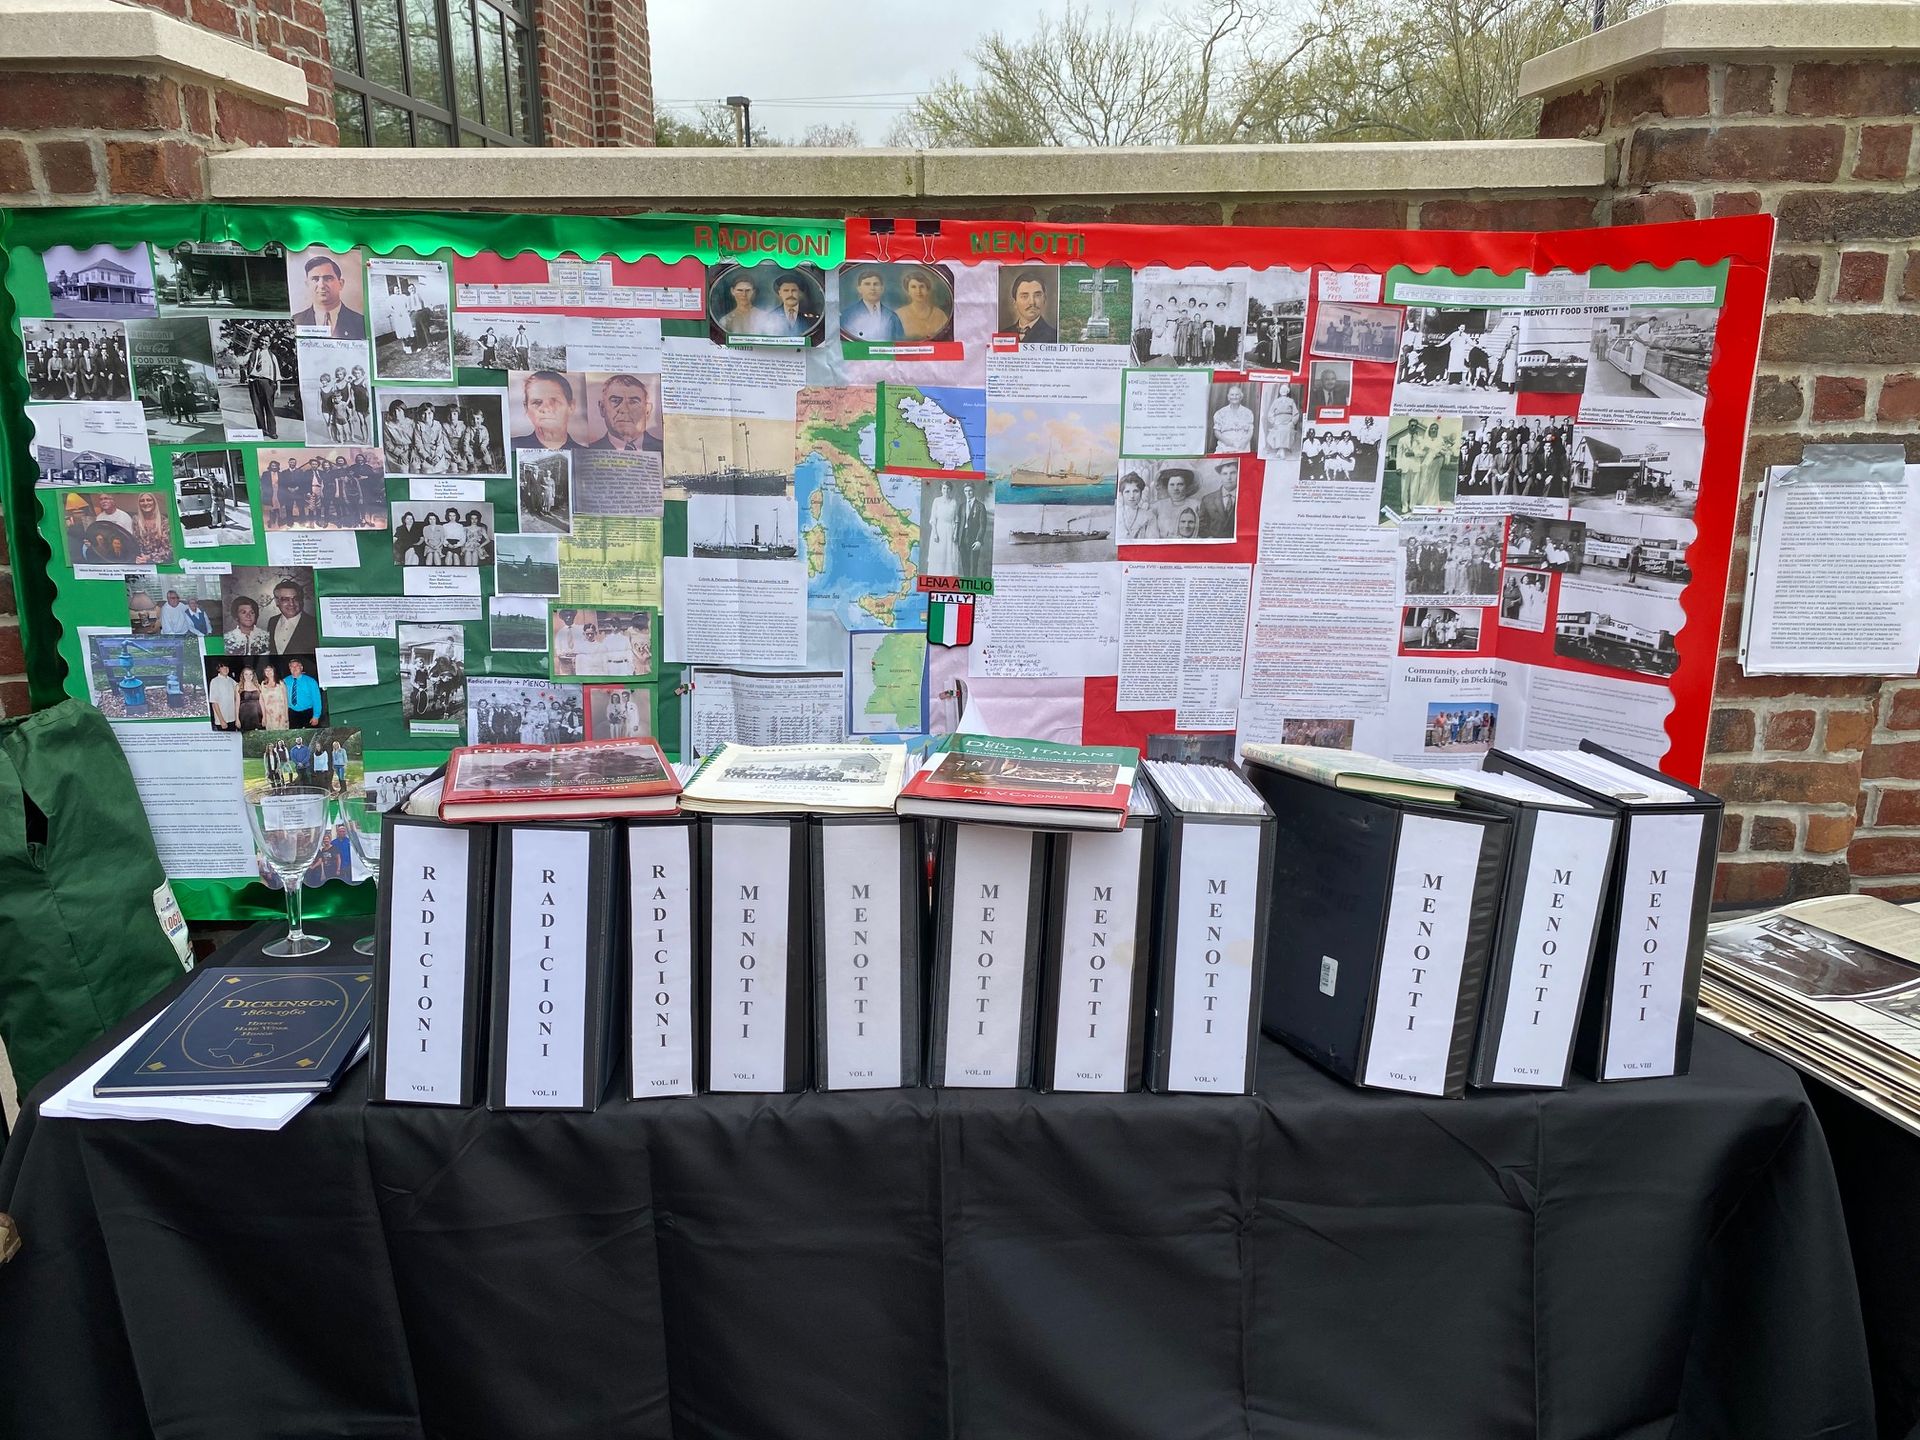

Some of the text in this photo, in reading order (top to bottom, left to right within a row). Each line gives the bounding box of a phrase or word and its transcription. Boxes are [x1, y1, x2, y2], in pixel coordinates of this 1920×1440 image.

[695, 226, 831, 257] RADICIONI
[970, 231, 1085, 255] MENOTTI
[1523, 305, 1610, 317] MENOTTI FOOD STORE
[1022, 343, 1095, 353] S.S. Citta Di Torino
[133, 355, 178, 364] FOOD STORE
[917, 417, 943, 425] MARCHE
[862, 496, 883, 505] ITALY
[1423, 515, 1441, 523] Family
[919, 575, 992, 592] LENA ATTILIO
[934, 593, 970, 603] ITALY
[1407, 666, 1507, 678] Community, church keep
[1404, 675, 1508, 687] Italian family in Dickinson
[965, 740, 1115, 758] DELTA ITALIANS
[558, 785, 629, 793] CANONICI
[963, 788, 993, 796] PAUL
[1009, 792, 1071, 800] CANONICI
[164, 911, 182, 931] LOGO
[1407, 873, 1444, 1032] MENOTTI
[1532, 869, 1572, 1026] MENOTTI
[1639, 869, 1667, 1022] MENOTTI
[417, 866, 437, 1054] RADICIONI
[539, 869, 557, 1057] RADICIONI
[652, 864, 670, 1049] RADICIONI
[739, 885, 760, 1039] MENOTTI
[850, 884, 872, 1038] MENOTTI
[976, 884, 1000, 1037] MENOTTI
[1088, 886, 1113, 1039] MENOTTI
[1204, 879, 1227, 1035] MENOTTI
[222, 999, 340, 1008] DICKINSON
[241, 1008, 306, 1017] 1860-1960
[1389, 1071, 1417, 1082] VOL. VI
[411, 1084, 429, 1092] VOL.
